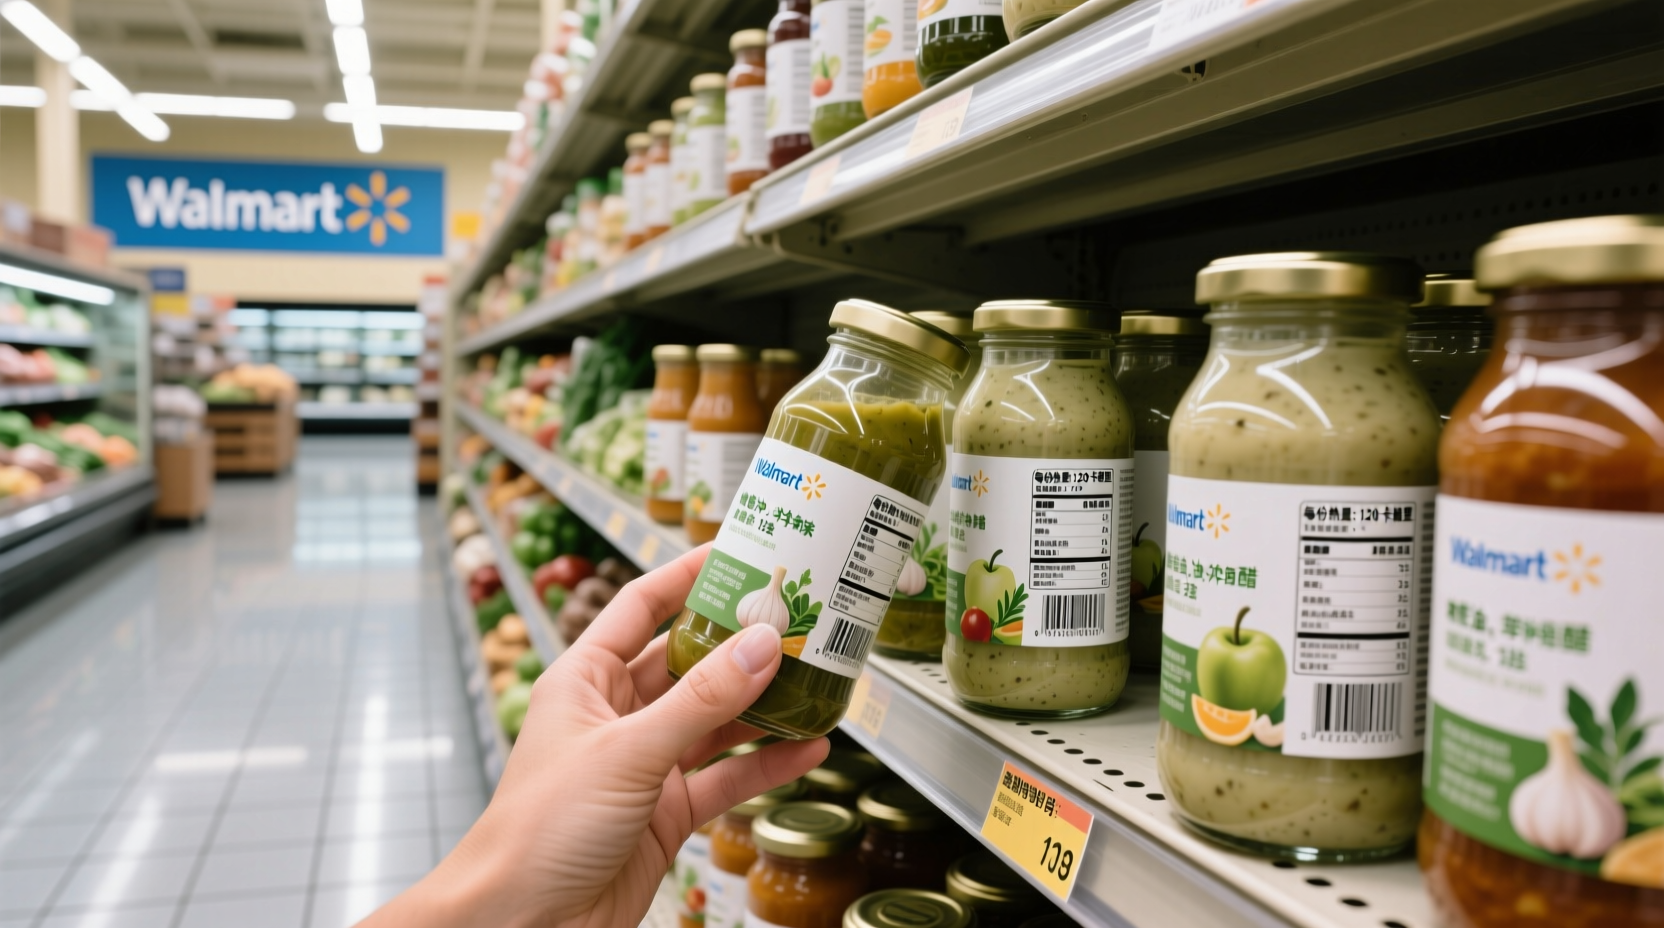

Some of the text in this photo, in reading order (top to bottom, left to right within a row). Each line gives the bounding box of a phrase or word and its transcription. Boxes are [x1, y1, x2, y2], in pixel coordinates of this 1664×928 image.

[126, 175, 344, 235] Walmart
[755, 457, 803, 491] Walmart
[1450, 537, 1549, 581] Walmart
